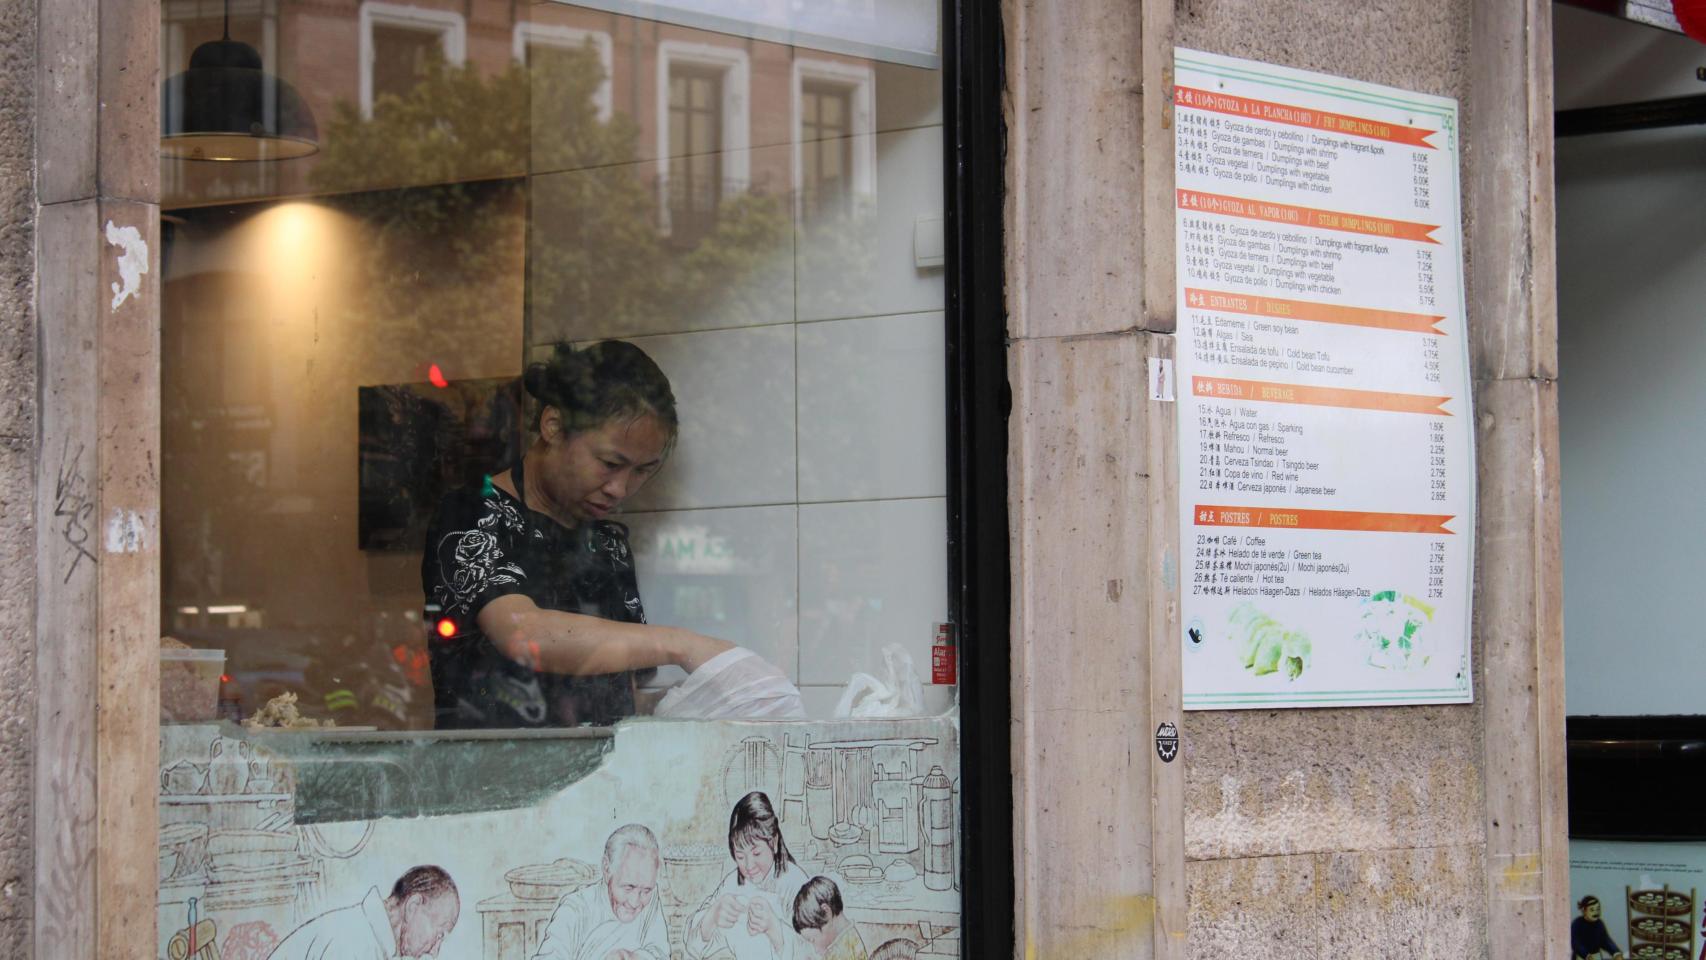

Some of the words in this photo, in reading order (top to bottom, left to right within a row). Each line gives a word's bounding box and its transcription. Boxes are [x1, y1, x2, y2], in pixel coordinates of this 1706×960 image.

[1225, 120, 1244, 134] Gyoza
[1212, 130, 1231, 144] Gyoza
[1242, 135, 1265, 149] gambas
[1274, 140, 1304, 155] Dumplings
[1306, 145, 1317, 155] with
[1319, 147, 1338, 161] shrimp
[1212, 143, 1232, 156] Gyoza
[1242, 147, 1264, 159] ternera
[1272, 152, 1302, 167] Dumplings
[1304, 157, 1316, 167] with
[1206, 154, 1226, 168] Gyoza
[1227, 157, 1248, 171] vegetal
[1257, 161, 1288, 177] Dumplings
[1290, 166, 1301, 177] with
[1302, 168, 1330, 183] vegetable
[1214, 167, 1233, 181] Gyoza
[1243, 171, 1257, 184] pollo
[1266, 174, 1296, 190] Dumplings
[1298, 179, 1309, 190] with
[1311, 181, 1333, 193] chicken
[1230, 225, 1249, 238] Gyoza
[1218, 235, 1237, 249] Gyoza
[1247, 239, 1271, 253] gambas
[1279, 243, 1308, 257] Dumplings
[1310, 247, 1321, 257] with
[1219, 247, 1237, 261] Gyoza
[1277, 255, 1307, 269] Dumplings
[1309, 259, 1320, 268] with
[1214, 259, 1233, 272] Gyoza
[1234, 261, 1254, 274] vegetal
[1263, 265, 1294, 279] Dumplings
[1295, 268, 1306, 278] with
[1225, 272, 1244, 285] Gyoza
[1254, 275, 1268, 288] pollo
[1276, 278, 1305, 292] Dumplings
[1307, 282, 1318, 292] with
[1254, 321, 1272, 332] Green
[1273, 325, 1283, 335] soy
[1231, 343, 1257, 354] Ensalada
[1287, 348, 1301, 358] Cold
[1302, 350, 1316, 360] bean
[1232, 355, 1259, 366] Ensalada
[1268, 359, 1288, 371] pepino
[1297, 361, 1310, 371] Cold
[1311, 363, 1325, 372] bean
[1216, 406, 1231, 418] Agua
[1240, 408, 1258, 418] Water
[1229, 419, 1245, 431] Agua
[1246, 422, 1257, 430] con
[1259, 423, 1270, 433] gas
[1223, 431, 1250, 442] Refresco
[1258, 433, 1284, 444] Refresco
[1224, 444, 1244, 454] Mahou
[1253, 445, 1274, 456] Normal
[1275, 447, 1289, 456] beer
[1224, 456, 1249, 467] Cerveza
[1306, 460, 1319, 471] beer
[1225, 468, 1240, 481] Copa
[1251, 470, 1263, 480] vino
[1272, 471, 1284, 481] Red
[1285, 472, 1299, 482] wine
[1238, 482, 1262, 492] Cerveza
[1295, 485, 1322, 497] Japanese
[1323, 486, 1336, 496] beer
[1220, 511, 1250, 524] POSTRES
[1270, 513, 1298, 526] POSTRES
[1223, 535, 1237, 546] Café
[1246, 536, 1266, 546] Coffee
[1229, 548, 1250, 558] Helado
[1268, 549, 1285, 559] verde
[1294, 550, 1311, 560] Green
[1312, 551, 1322, 560] tea
[1234, 561, 1253, 571] Mochi
[1298, 563, 1315, 572] Mochi
[1230, 574, 1254, 583] caliente
[1263, 574, 1274, 584] Hot
[1275, 575, 1285, 584] tea
[1233, 586, 1258, 595] Helados
[1309, 587, 1332, 597] Helados
